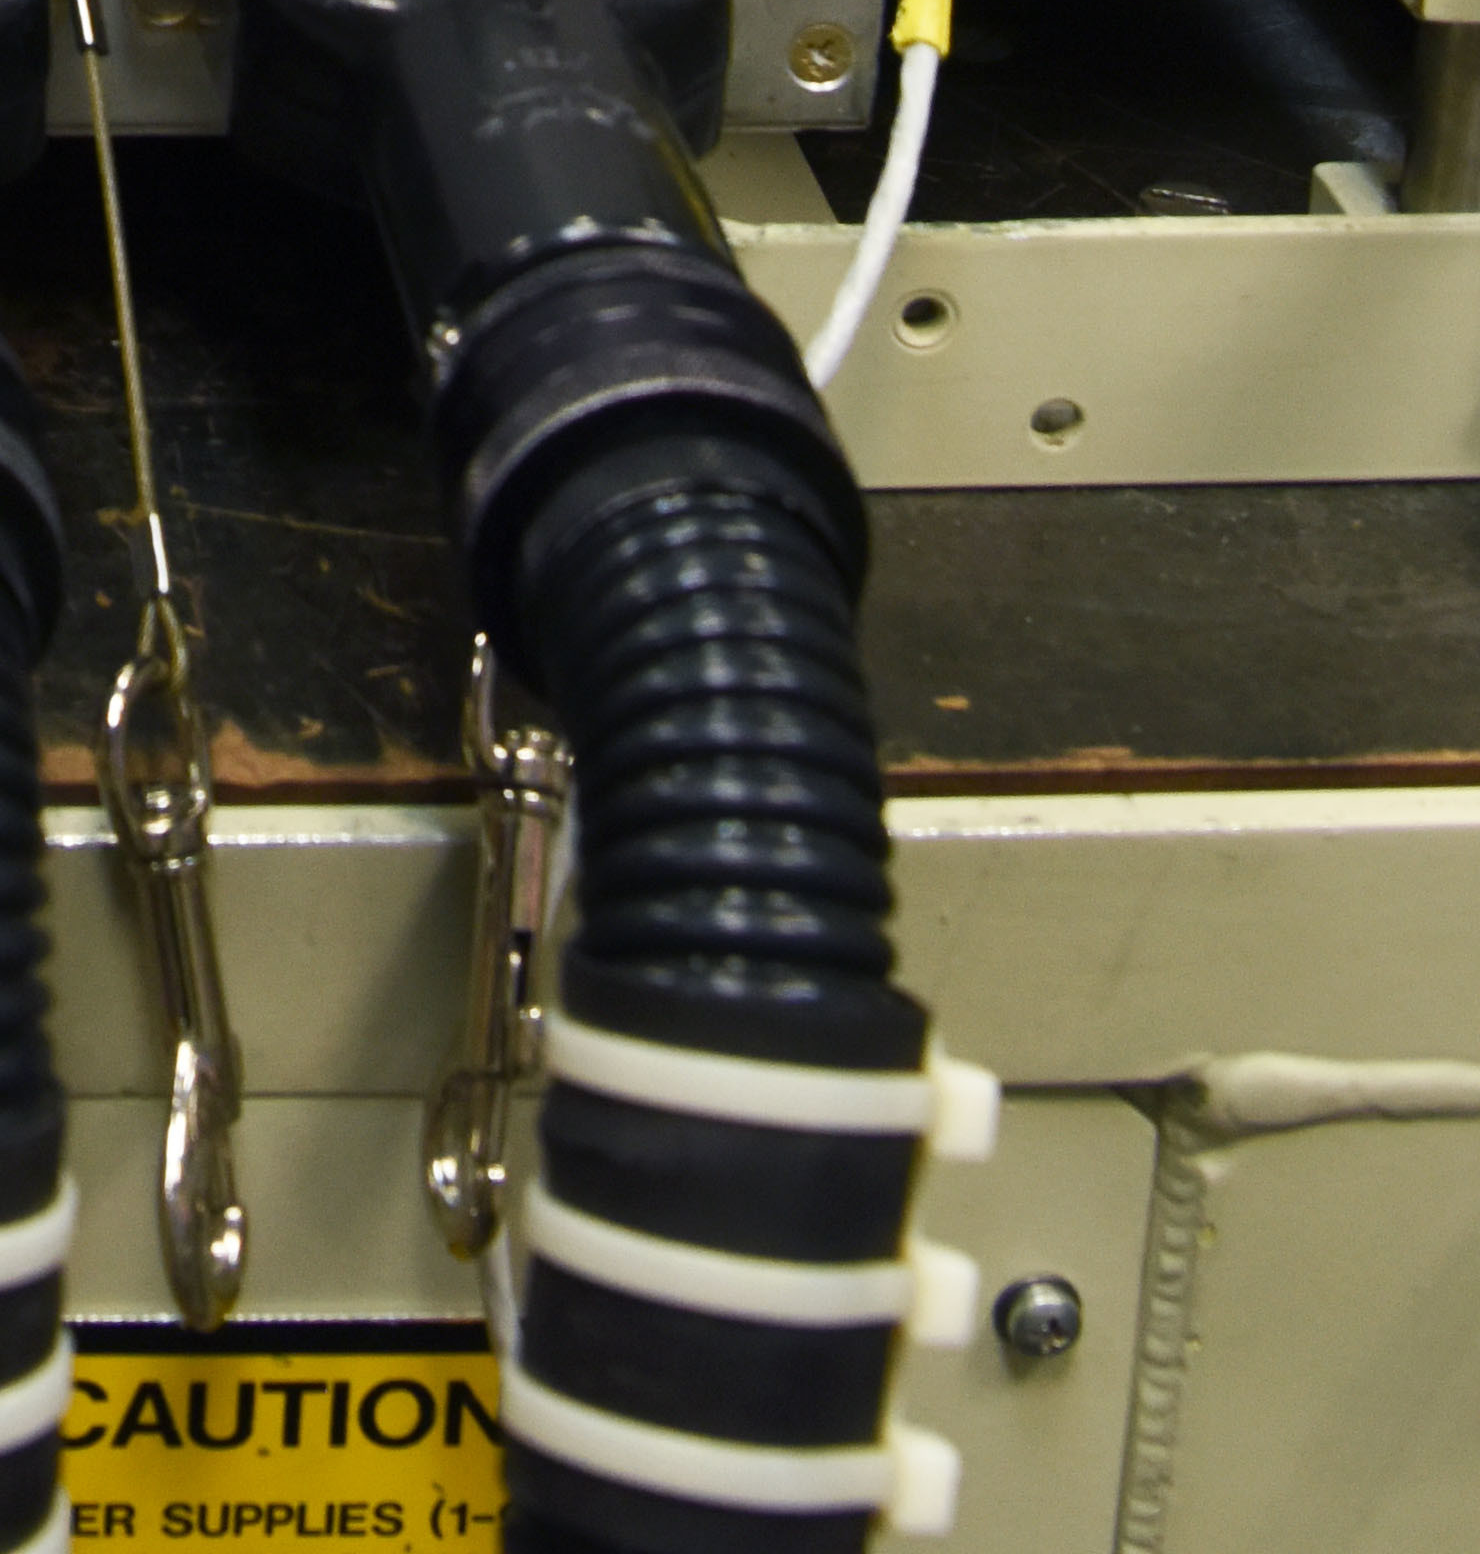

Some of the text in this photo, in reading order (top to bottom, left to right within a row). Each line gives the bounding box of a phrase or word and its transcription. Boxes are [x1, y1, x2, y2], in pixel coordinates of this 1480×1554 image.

[57, 1378, 509, 1451] CAUTION
[161, 1502, 404, 1538] SUPPLIES
[430, 1499, 508, 1541] (1-
